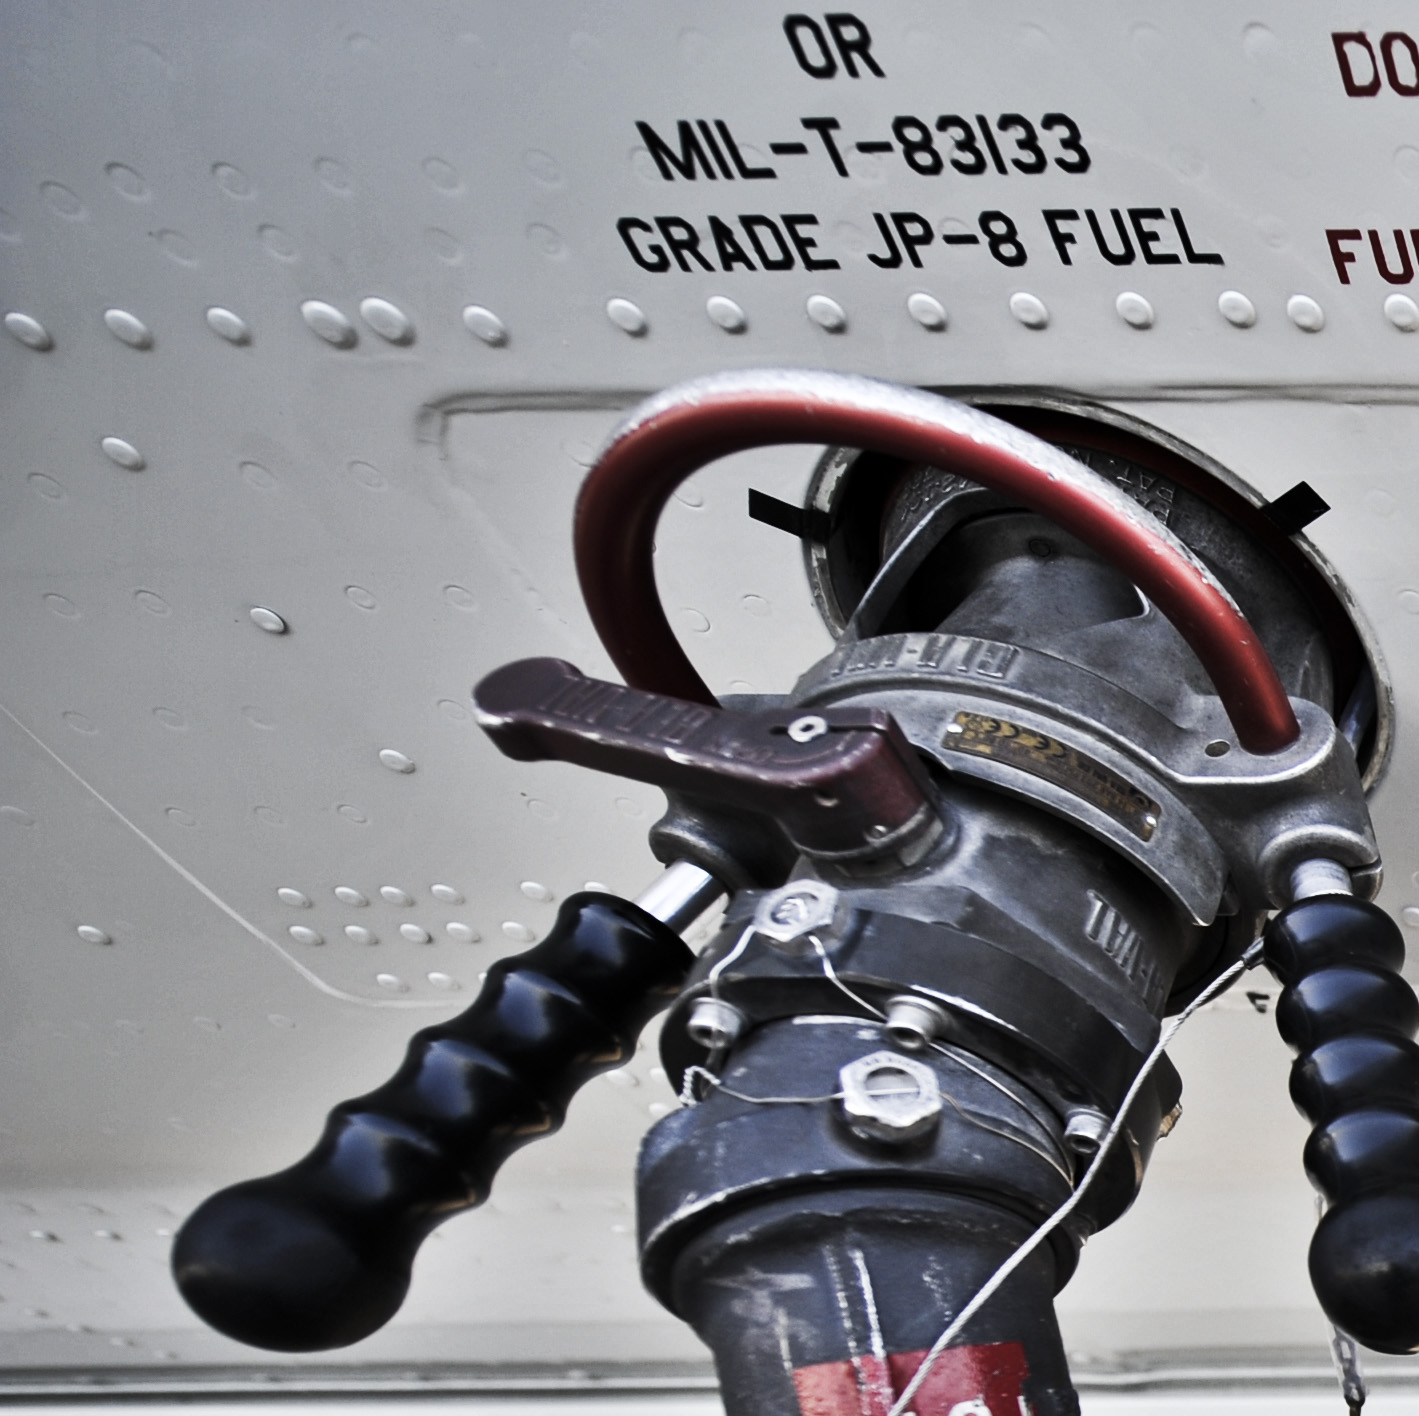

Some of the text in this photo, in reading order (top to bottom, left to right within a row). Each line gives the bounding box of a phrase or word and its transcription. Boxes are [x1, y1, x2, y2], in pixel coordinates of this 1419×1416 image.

[783, 14, 885, 79] OR
[636, 113, 1091, 181] MIL-T-83133
[617, 208, 1224, 272] GRADE JP-8 FUEL
